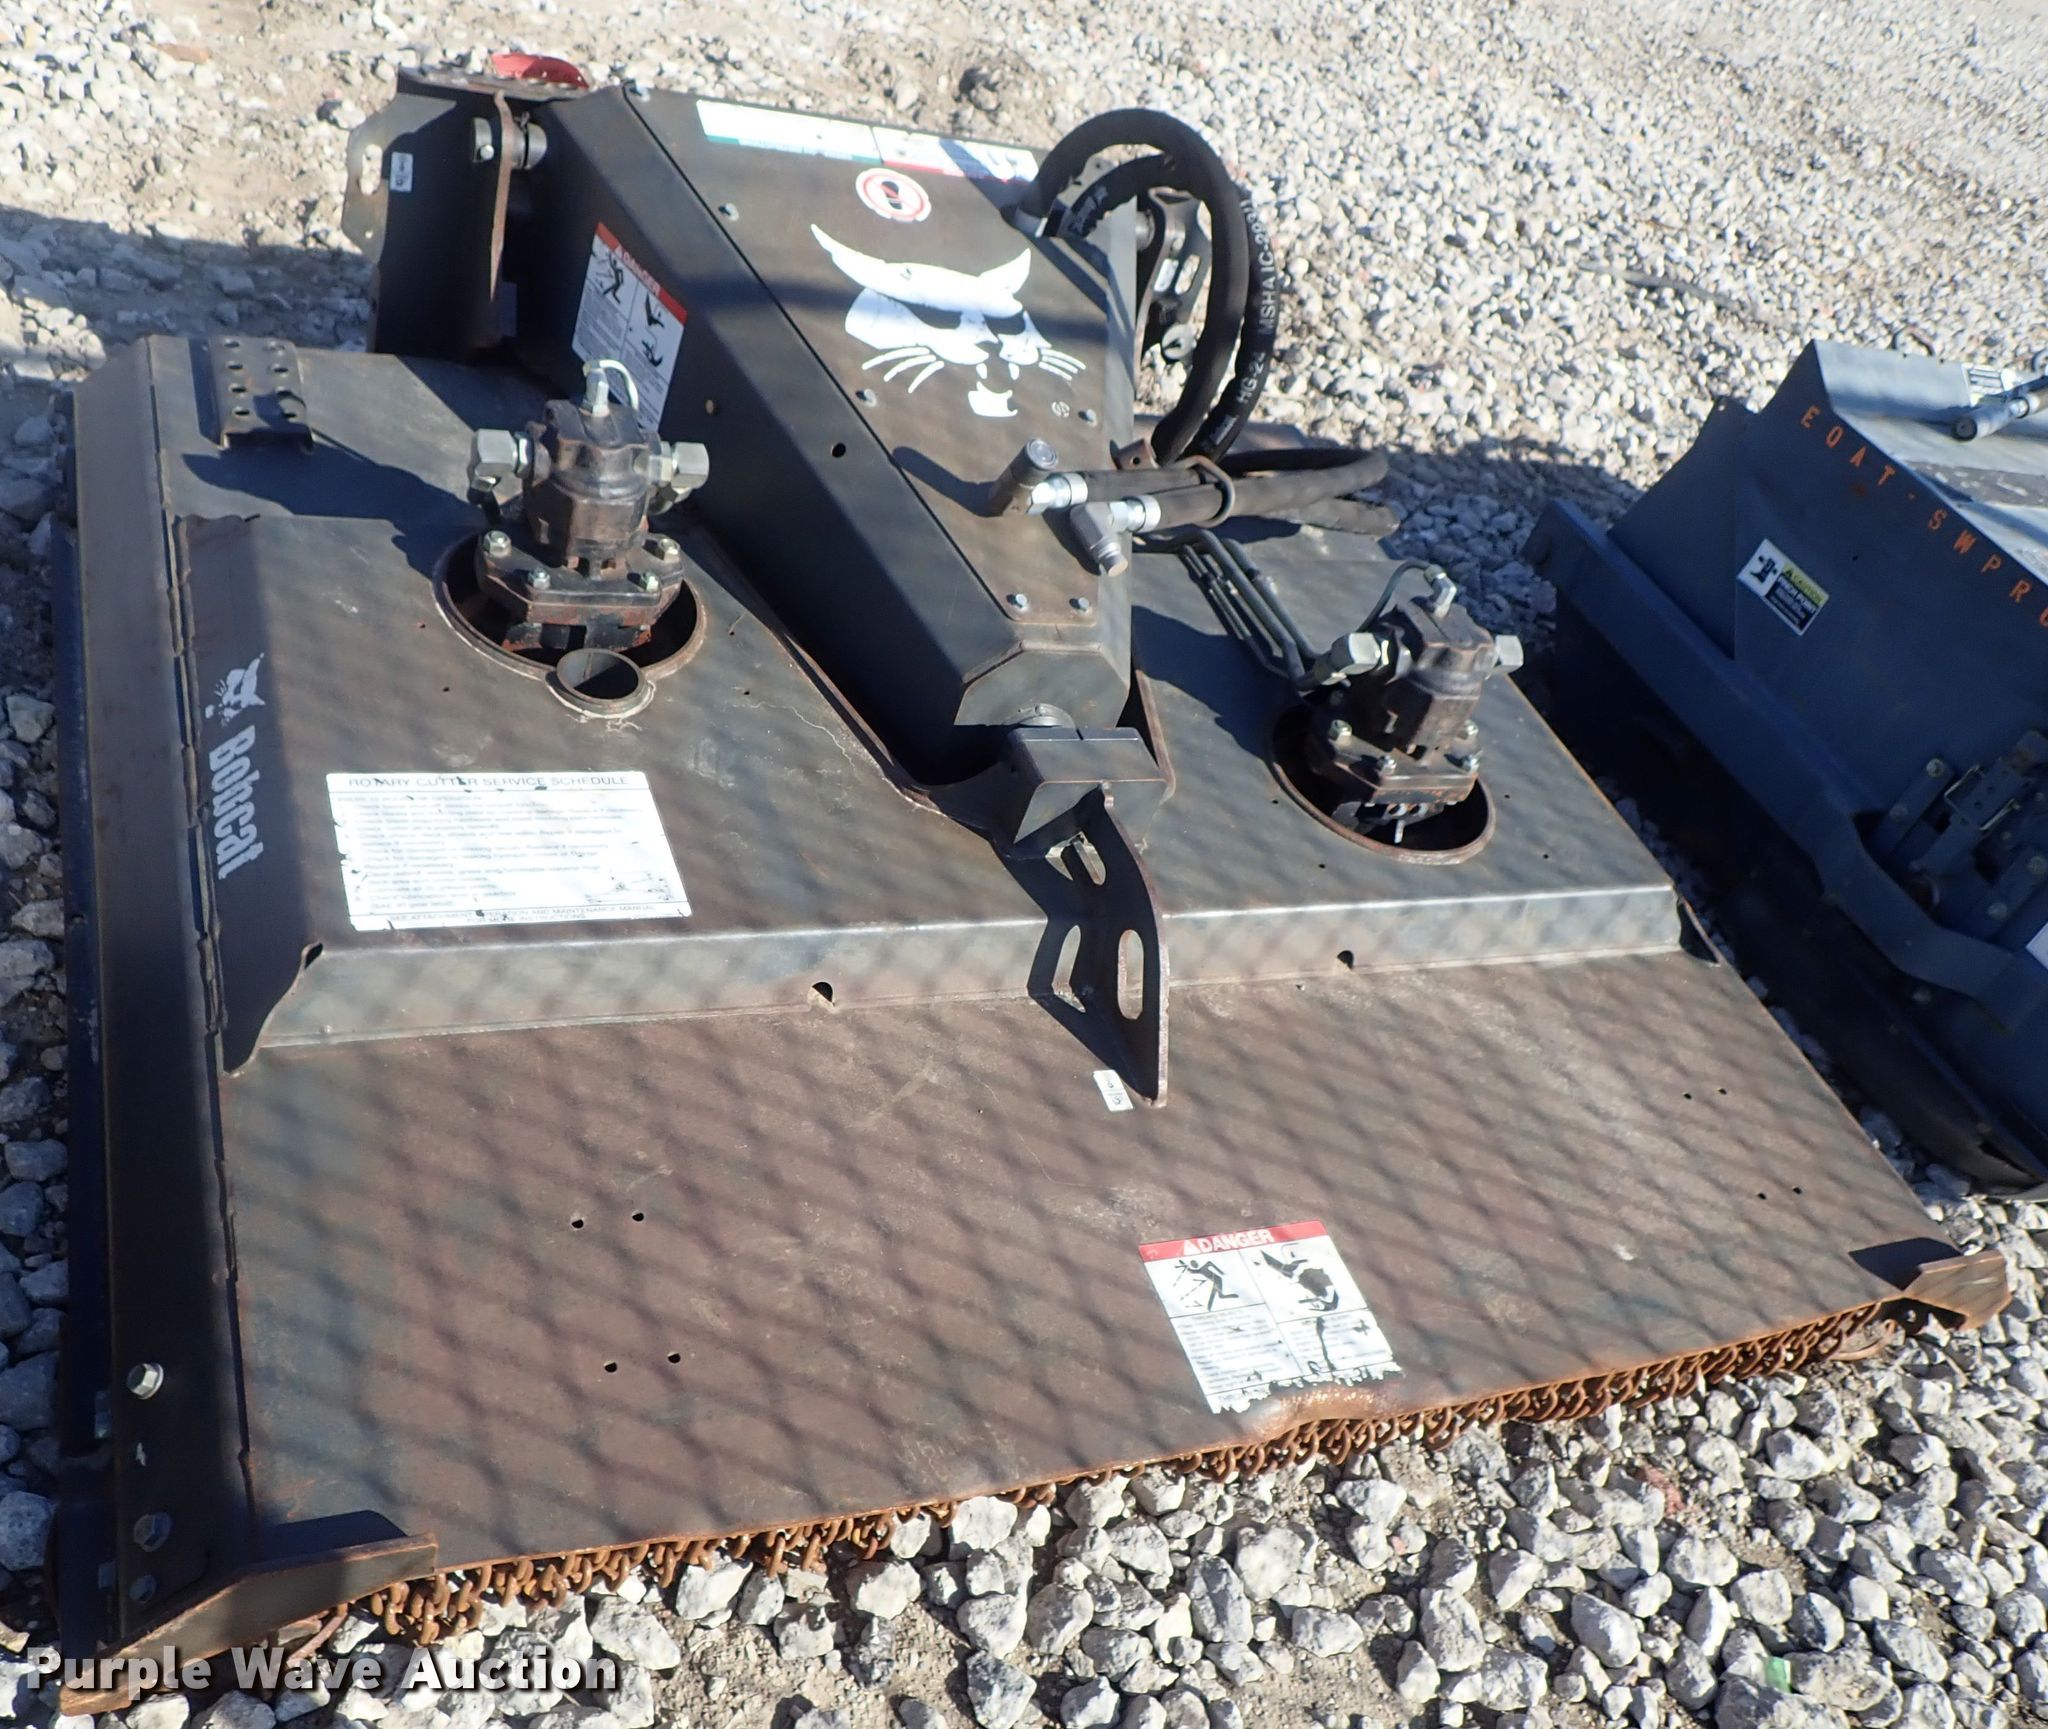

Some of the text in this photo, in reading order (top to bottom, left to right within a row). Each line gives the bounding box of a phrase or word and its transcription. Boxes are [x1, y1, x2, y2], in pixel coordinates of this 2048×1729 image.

[483, 776, 545, 786] SERVICE
[551, 776, 628, 786] SCHEDULE
[209, 725, 264, 880] Bobcat
[1196, 1228, 1275, 1253] DANGER
